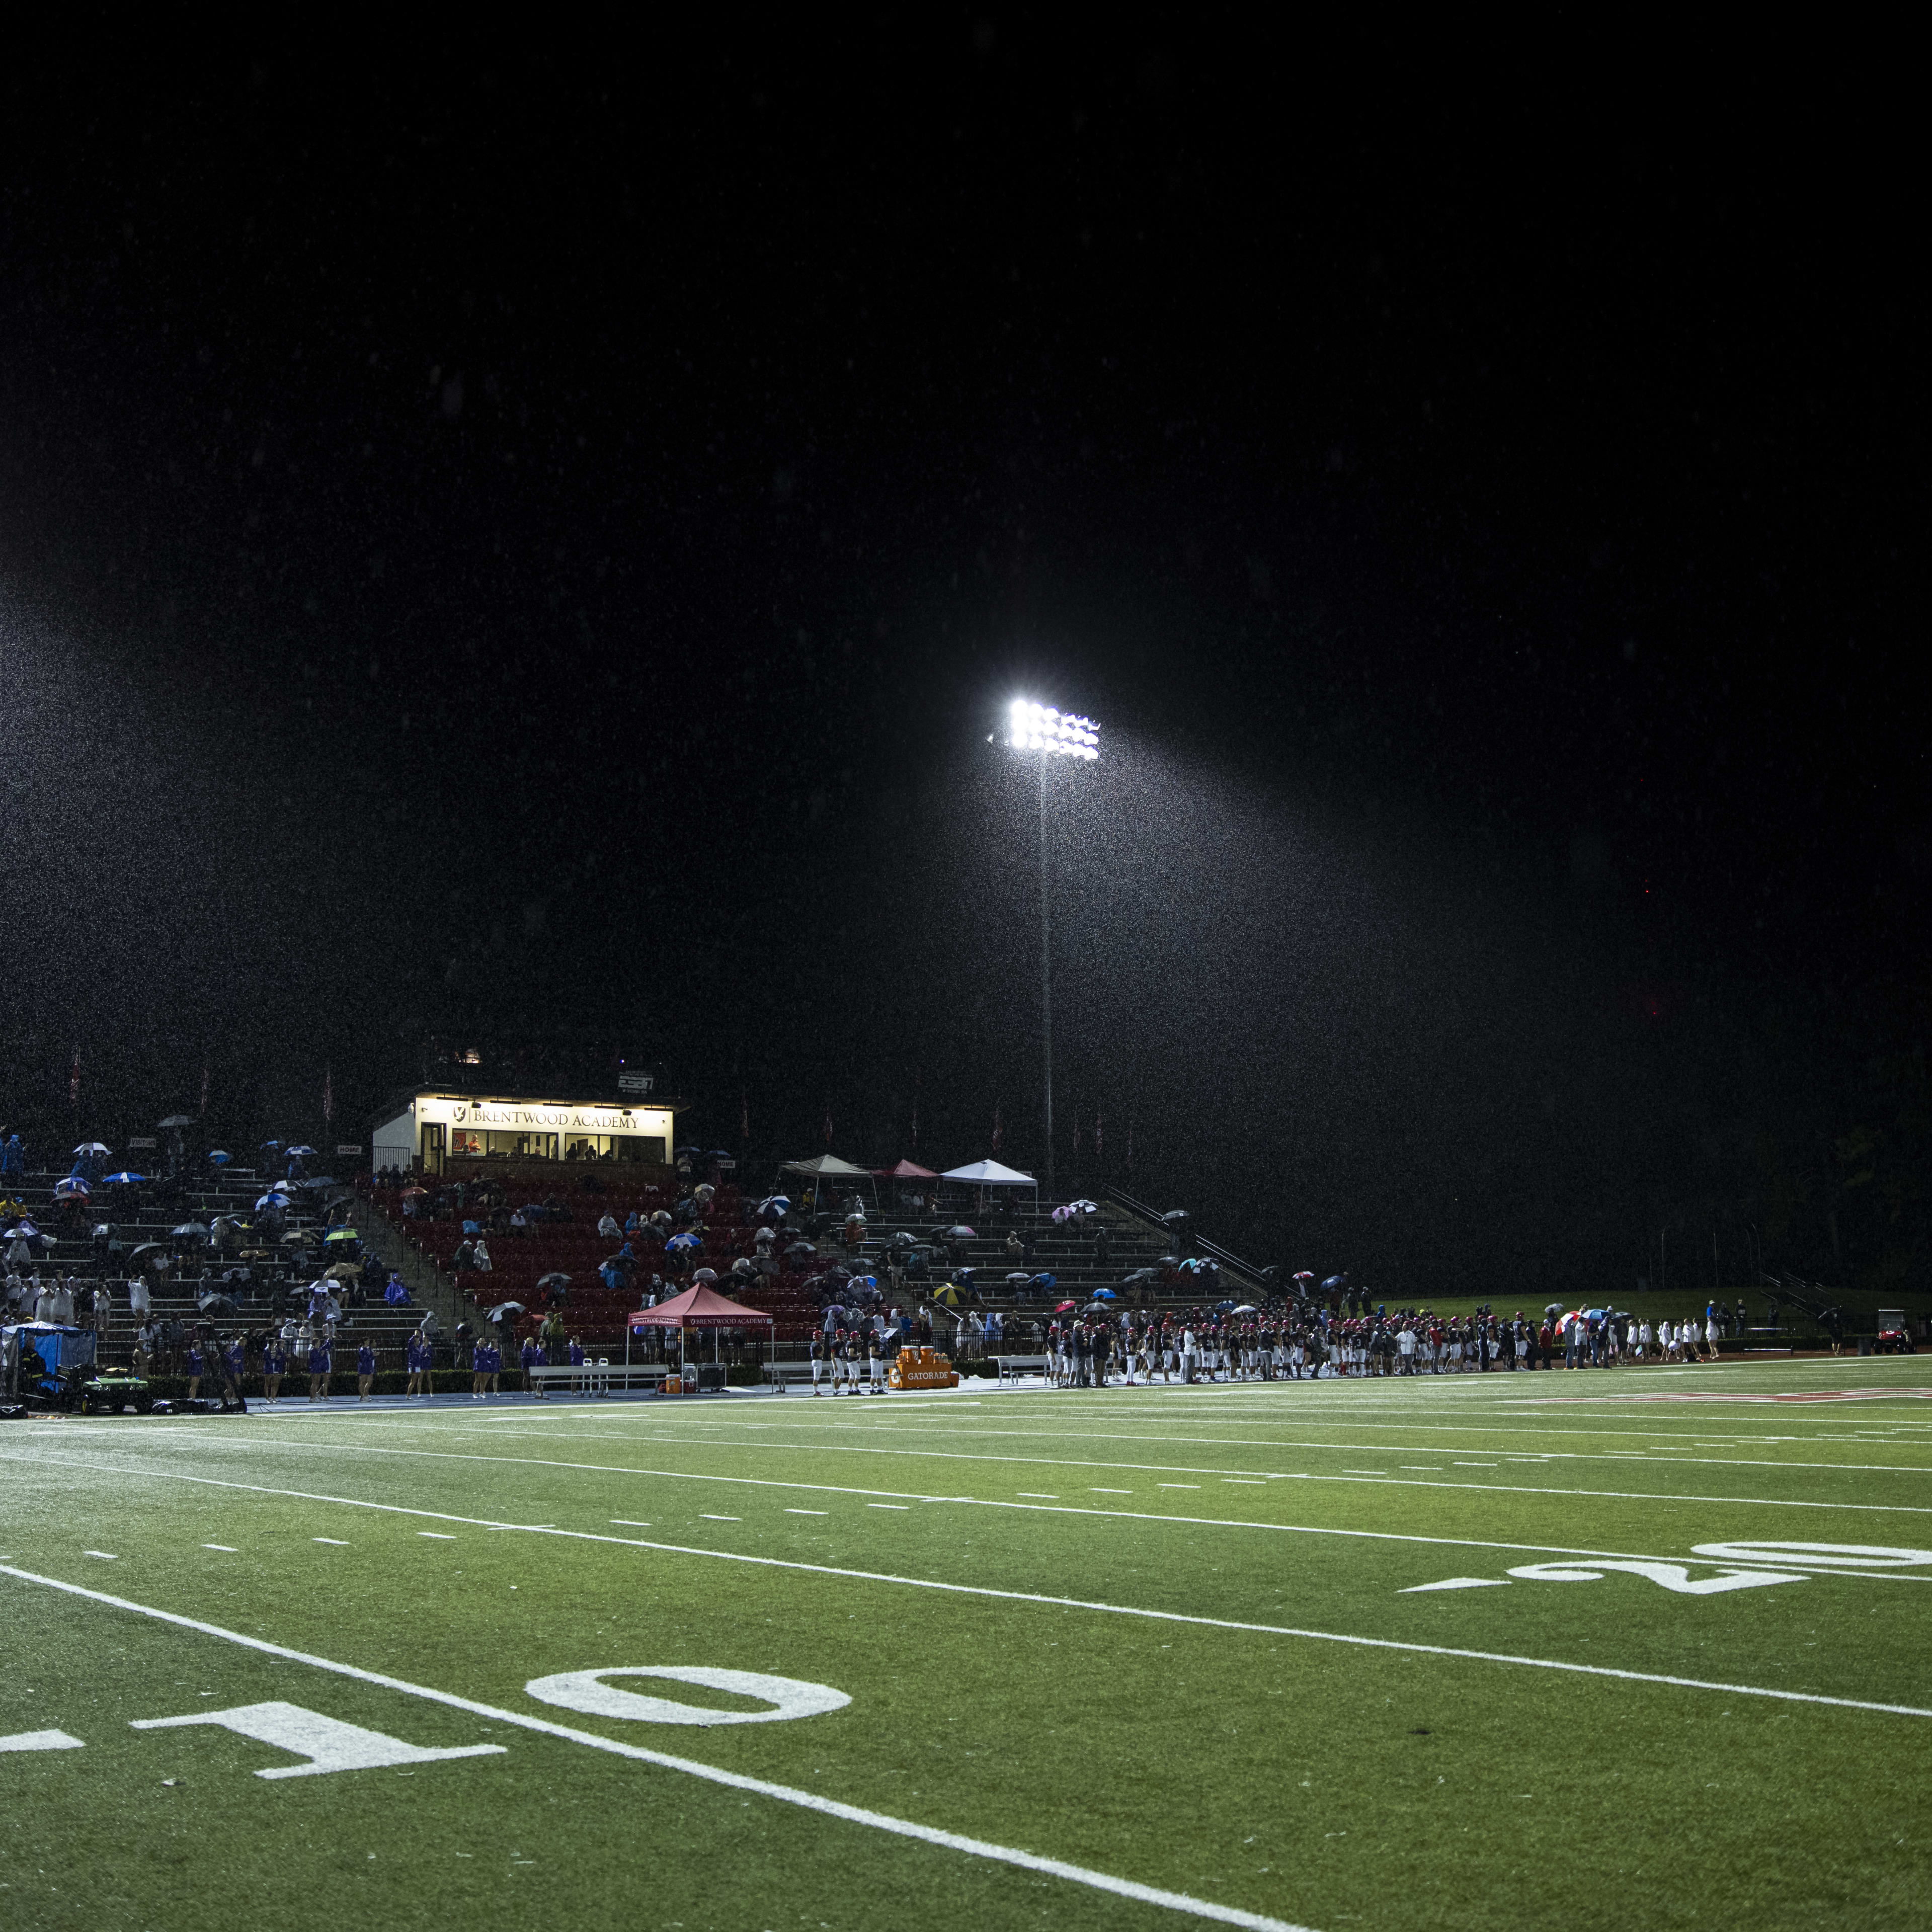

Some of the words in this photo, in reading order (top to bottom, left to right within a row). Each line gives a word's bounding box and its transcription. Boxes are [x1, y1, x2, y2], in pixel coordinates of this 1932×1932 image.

[474, 1110, 568, 1125] BRENTWOOD
[573, 1115, 639, 1129] ACADEMY
[891, 1368, 900, 1384] G
[908, 1372, 948, 1380] GATORADE
